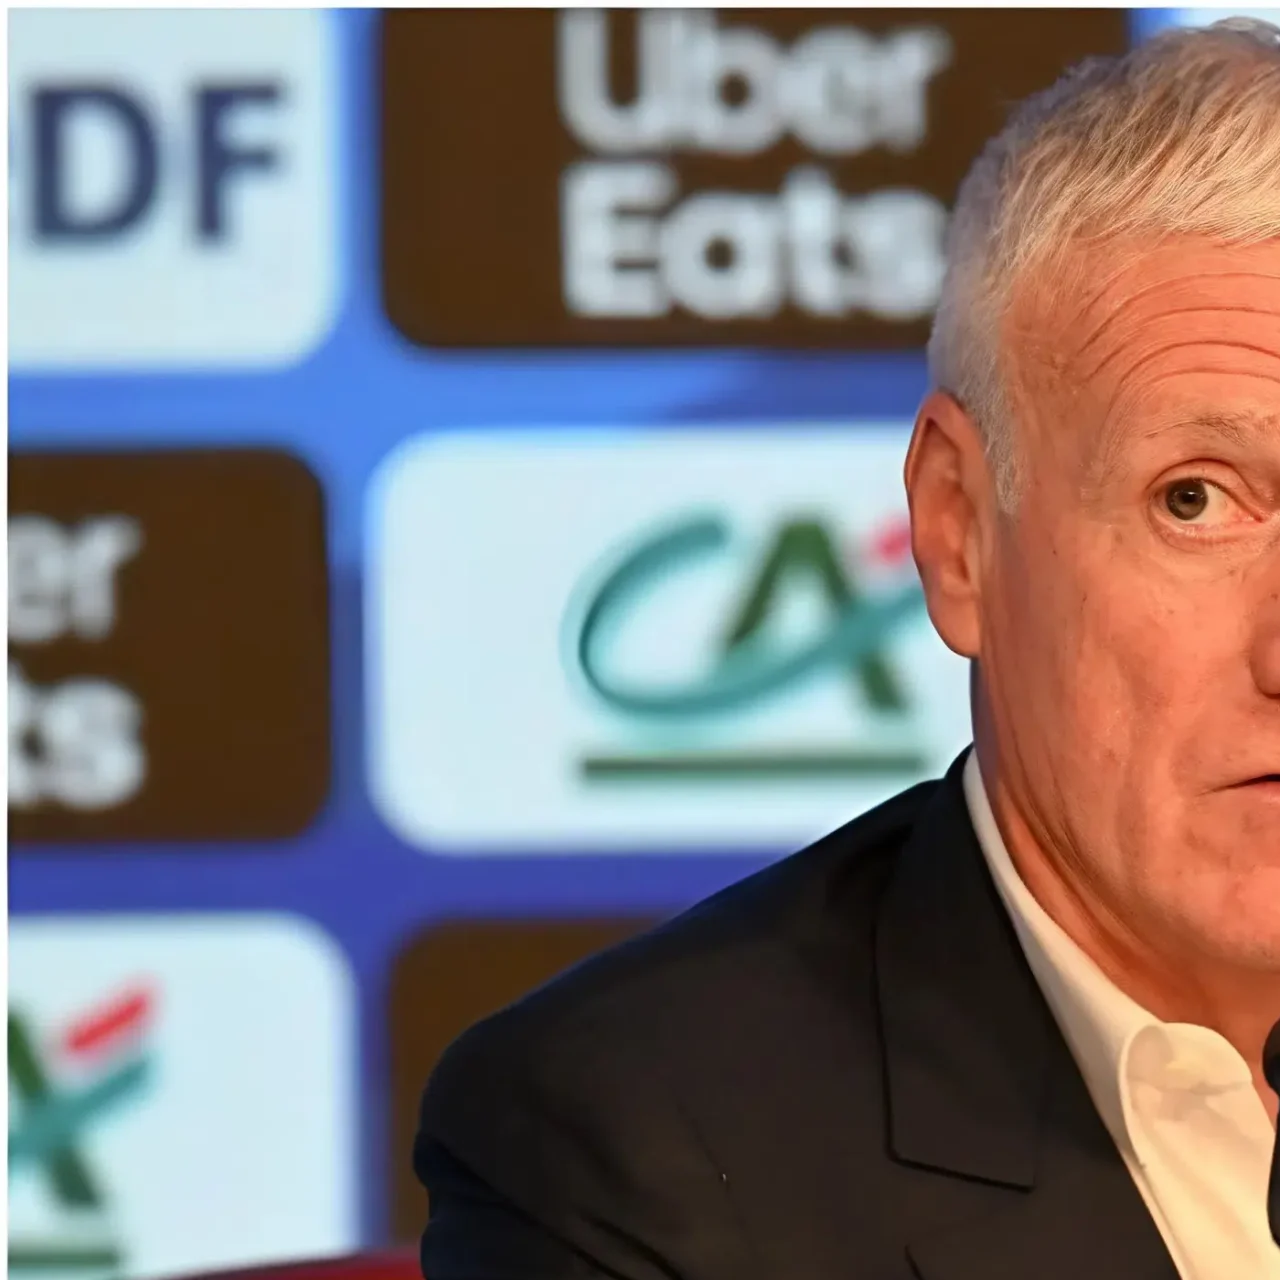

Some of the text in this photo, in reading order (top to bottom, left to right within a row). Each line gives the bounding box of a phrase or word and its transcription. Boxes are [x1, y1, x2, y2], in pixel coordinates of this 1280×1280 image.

[560, 8, 950, 153] Uber
[28, 78, 286, 244] DF
[560, 160, 946, 318] Eats
